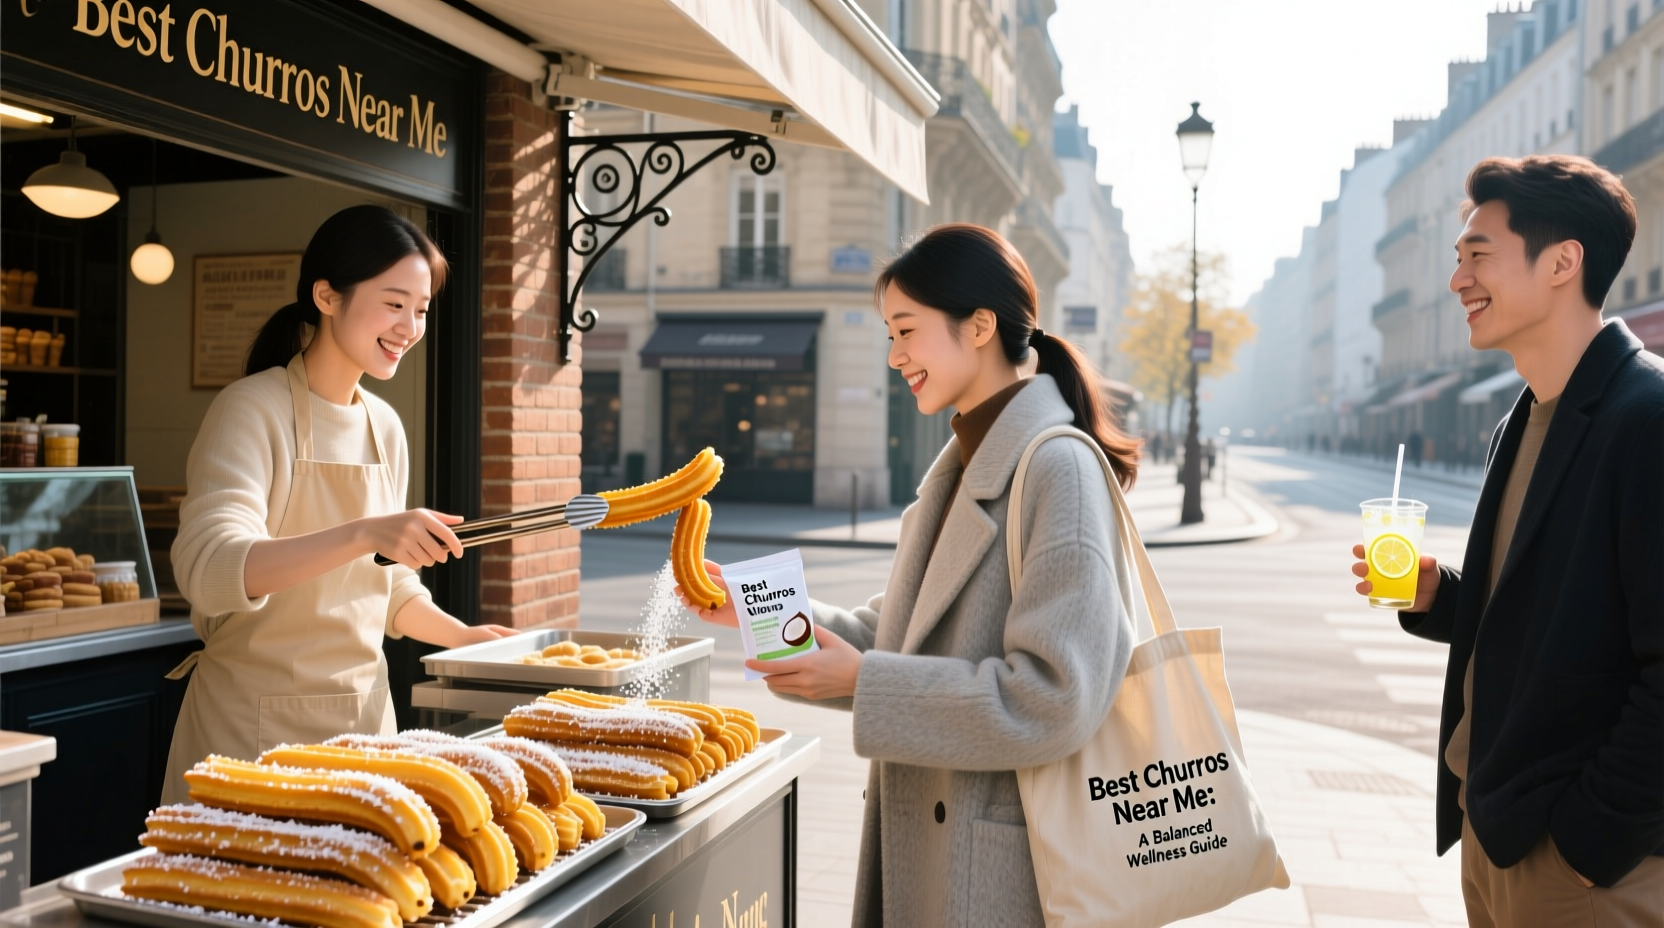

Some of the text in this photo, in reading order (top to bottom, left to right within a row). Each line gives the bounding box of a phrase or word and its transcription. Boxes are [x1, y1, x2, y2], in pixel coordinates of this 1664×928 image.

[186, 8, 330, 118] Churros
[336, 65, 404, 142] Near
[408, 94, 447, 158] Me
[741, 580, 767, 594] Best
[1088, 752, 1229, 801] Best Churros
[1112, 785, 1216, 825] Near Me:
[1126, 834, 1228, 868] Wellness Guide
[1138, 818, 1213, 848] A Balanced
